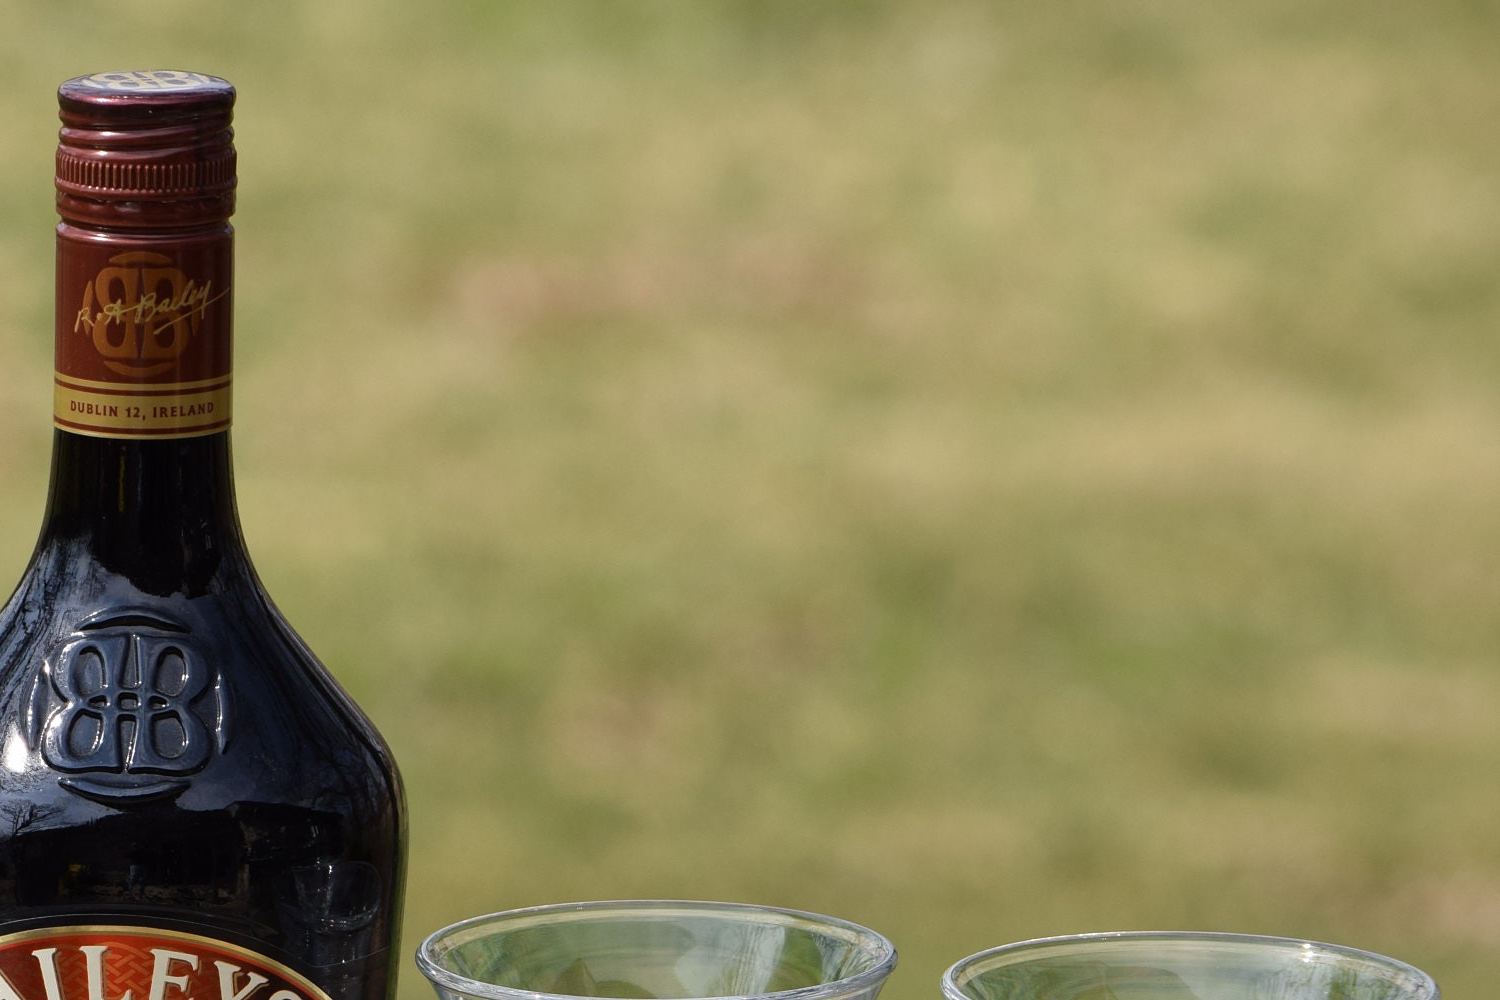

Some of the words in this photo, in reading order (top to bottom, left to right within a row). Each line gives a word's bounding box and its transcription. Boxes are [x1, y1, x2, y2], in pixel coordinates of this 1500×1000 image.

[70, 400, 118, 418] DUBLIN
[126, 406, 146, 421] 12,
[152, 401, 215, 419] IRELAND
